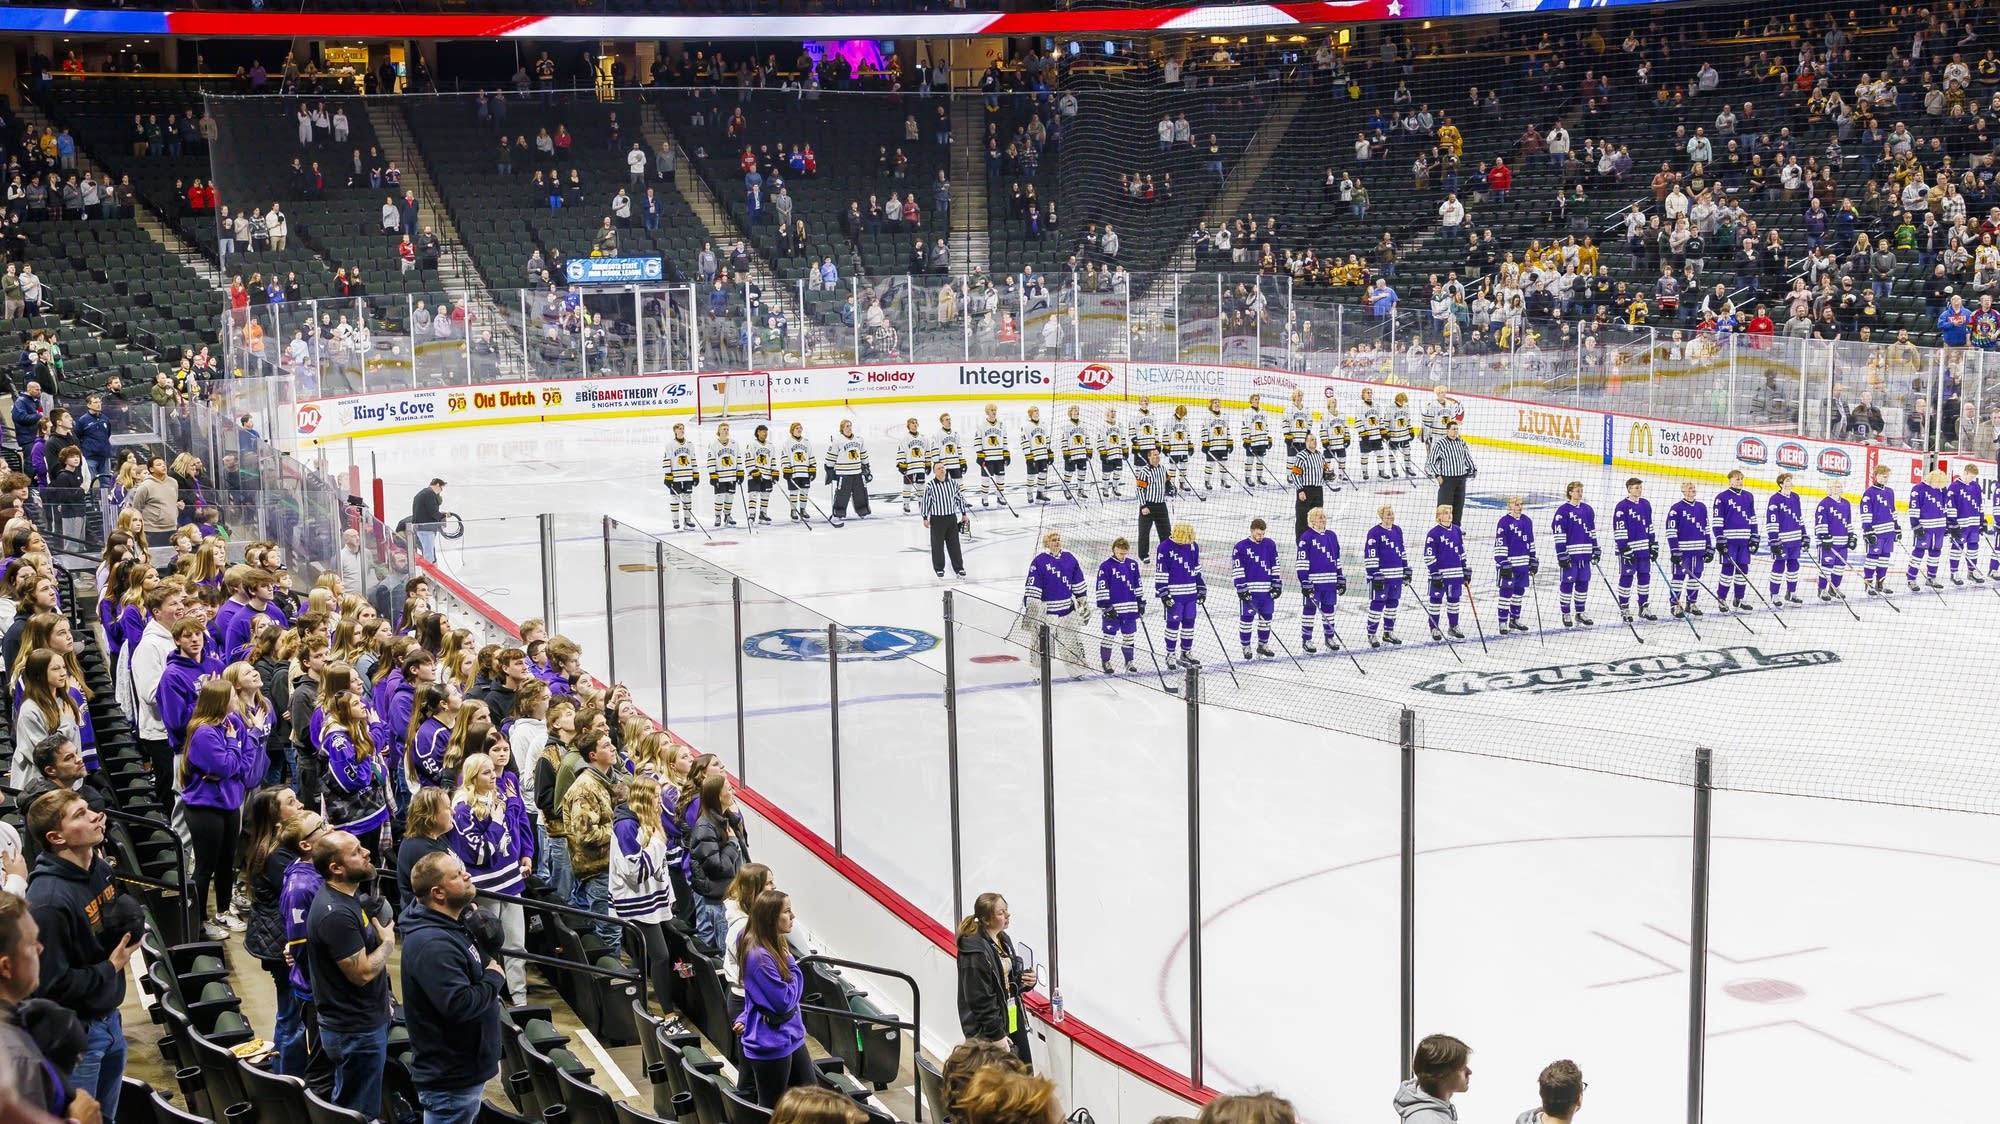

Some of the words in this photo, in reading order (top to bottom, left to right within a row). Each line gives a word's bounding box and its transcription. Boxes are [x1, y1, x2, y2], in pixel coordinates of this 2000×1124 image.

[740, 376, 810, 388] TRUSTONE
[868, 370, 915, 385] Holiday
[959, 366, 1050, 388] Integris.
[1082, 368, 1110, 384] DQ
[1253, 376, 1276, 387] NELSON
[667, 384, 686, 396] 45
[474, 392, 496, 408] Old
[500, 391, 536, 408] Dutch
[298, 409, 318, 428] DQ
[354, 403, 396, 421] King's
[400, 400, 434, 415] Cove
[394, 414, 434, 422] Marina.com
[1518, 409, 1581, 440] LiUNA!
[1660, 428, 1680, 443] Text
[1682, 430, 1714, 446] APPLY
[1660, 444, 1670, 455] to
[1672, 445, 1702, 460] 38000
[1741, 442, 1764, 458] HERO
[1780, 448, 1804, 464] HERO
[1822, 454, 1847, 472] HERO
